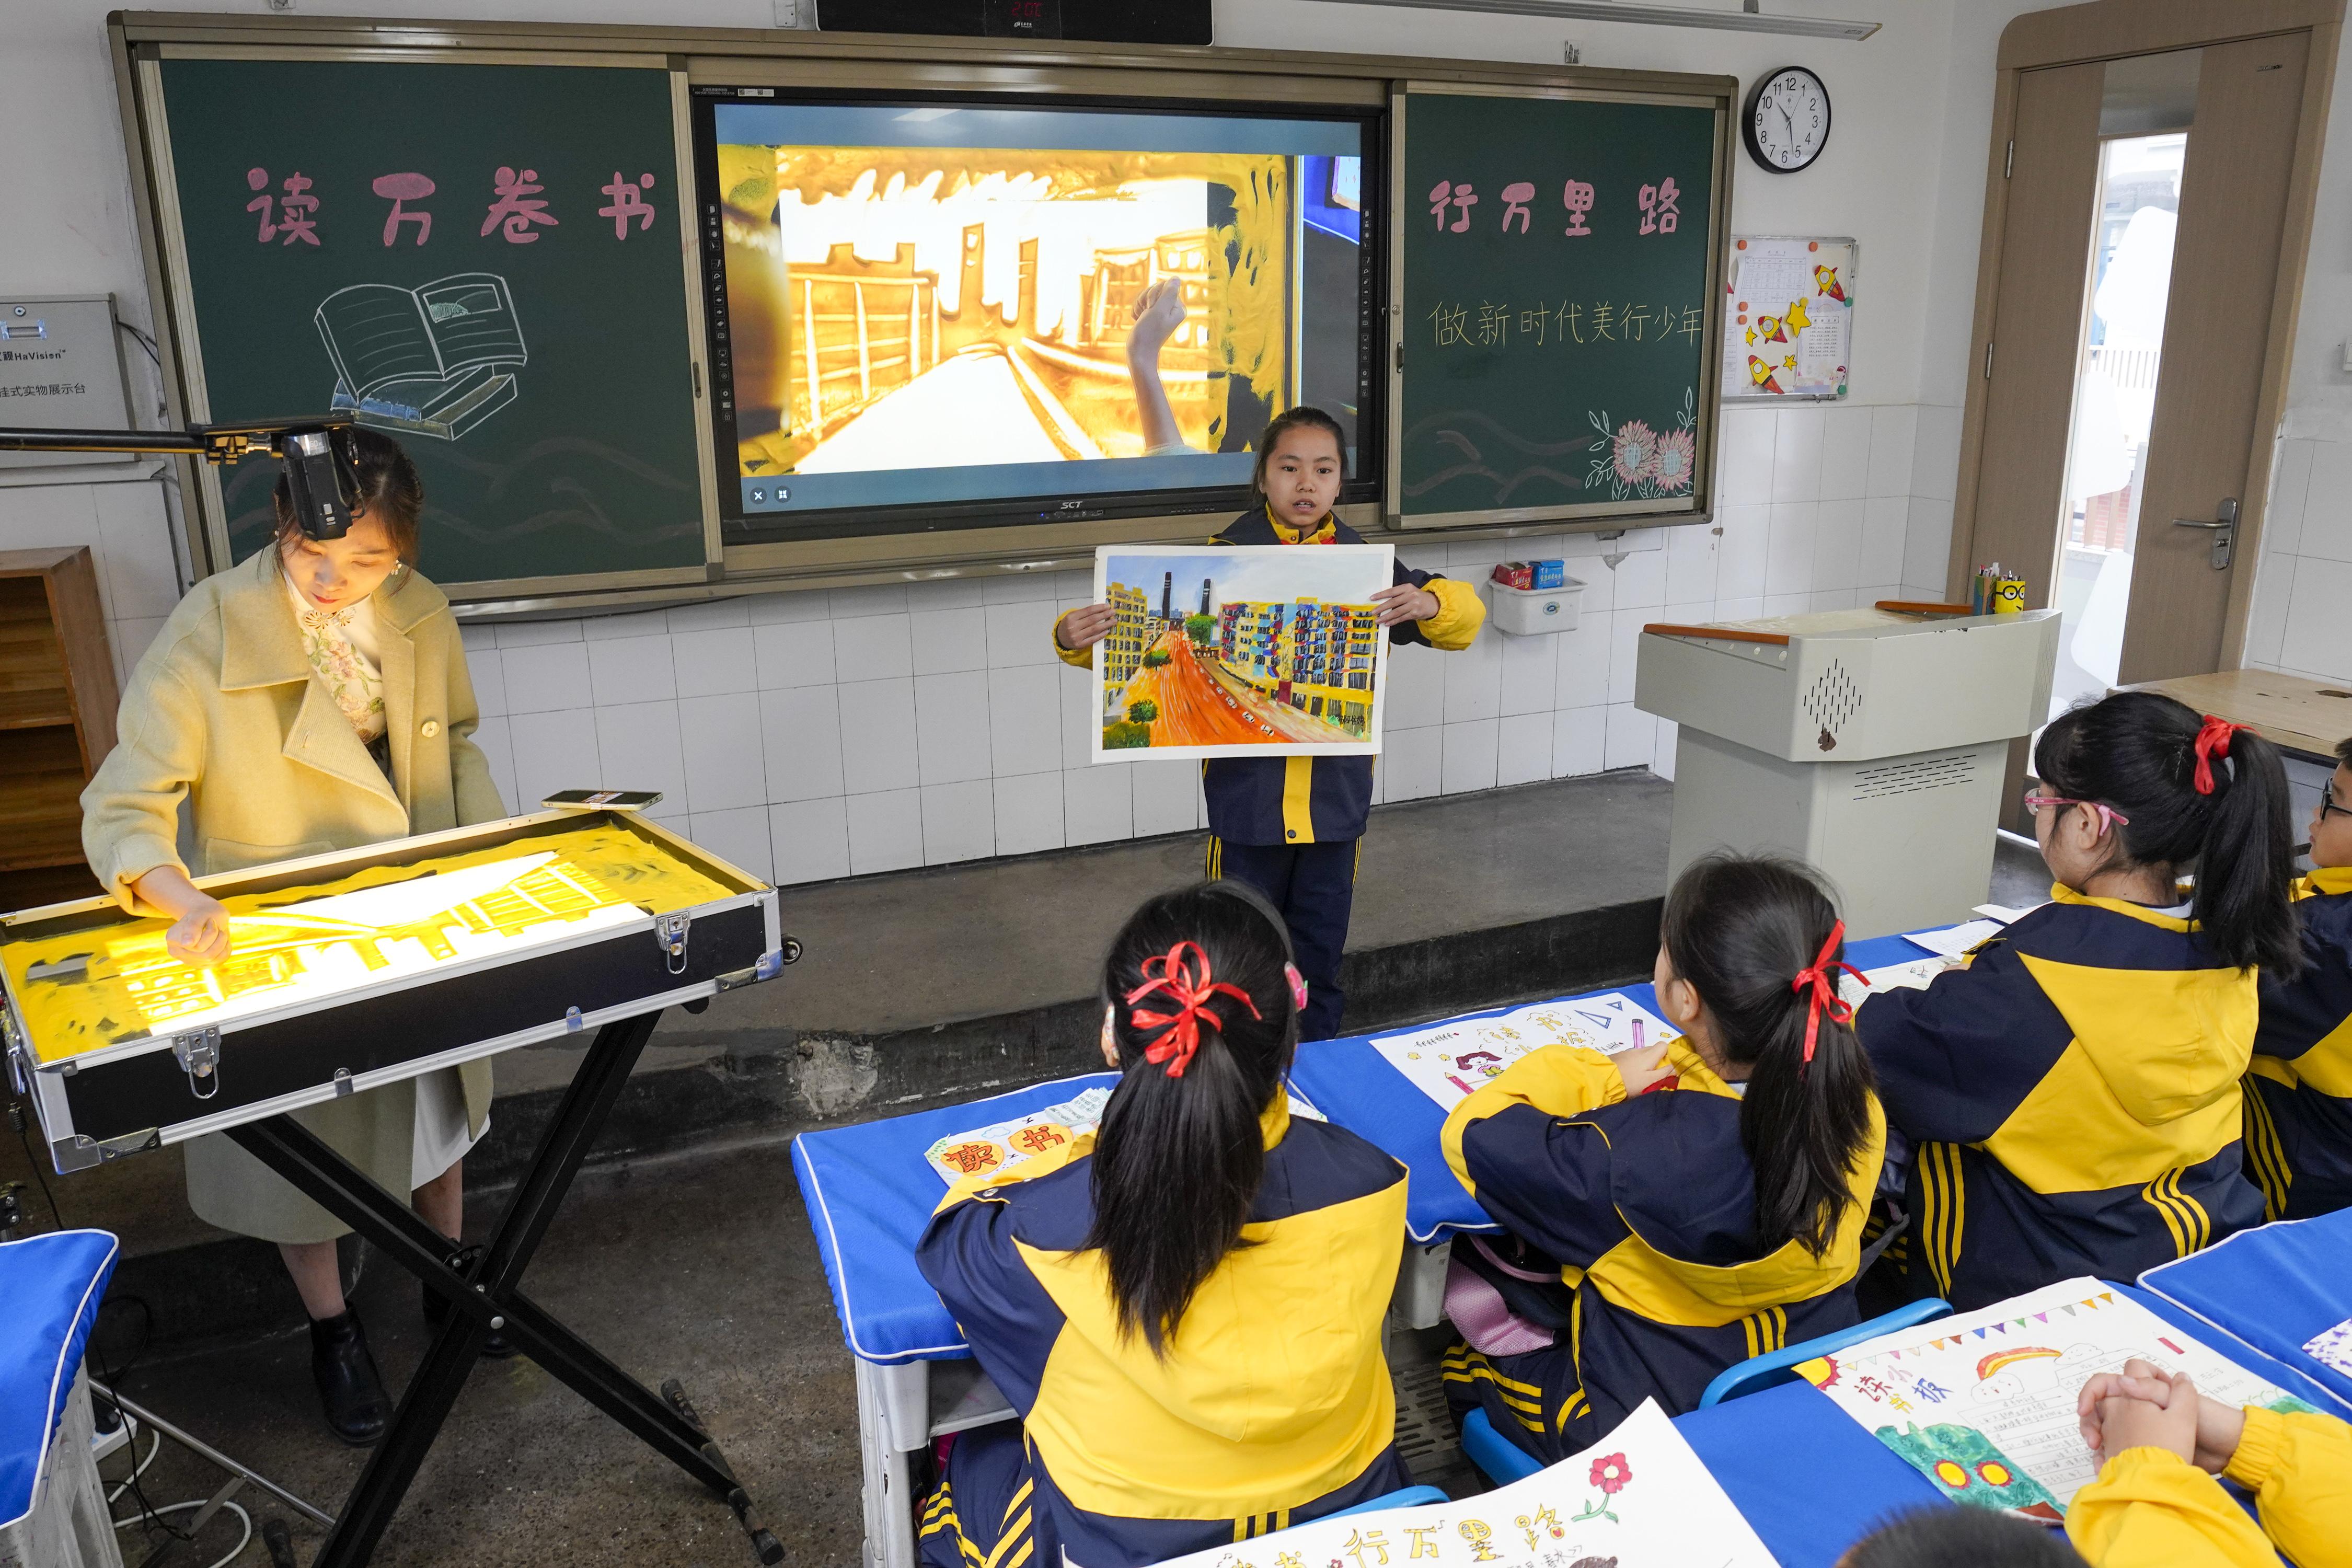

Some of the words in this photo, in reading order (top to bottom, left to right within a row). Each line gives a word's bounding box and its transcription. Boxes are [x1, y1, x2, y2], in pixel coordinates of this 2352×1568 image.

[1773, 83, 1781, 95] 11
[1785, 78, 1796, 90] 12
[1802, 84, 1806, 97] 1
[1762, 96, 1772, 109] 10
[1809, 98, 1816, 111] 2
[1756, 113, 1763, 126] 9
[1812, 115, 1818, 128] 3
[1760, 131, 1767, 143] 8
[1805, 132, 1811, 145] 4
[1770, 145, 1775, 157] 7
[1781, 151, 1788, 163] 6
[1795, 145, 1801, 158] 5
[247, 167, 655, 246] 读万卷书
[1429, 177, 1680, 236] 行万里路
[1426, 299, 1703, 349] 做新时代美行少年
[1060, 501, 1083, 510] SCT
[1344, 1503, 1563, 1568] 行万里路
